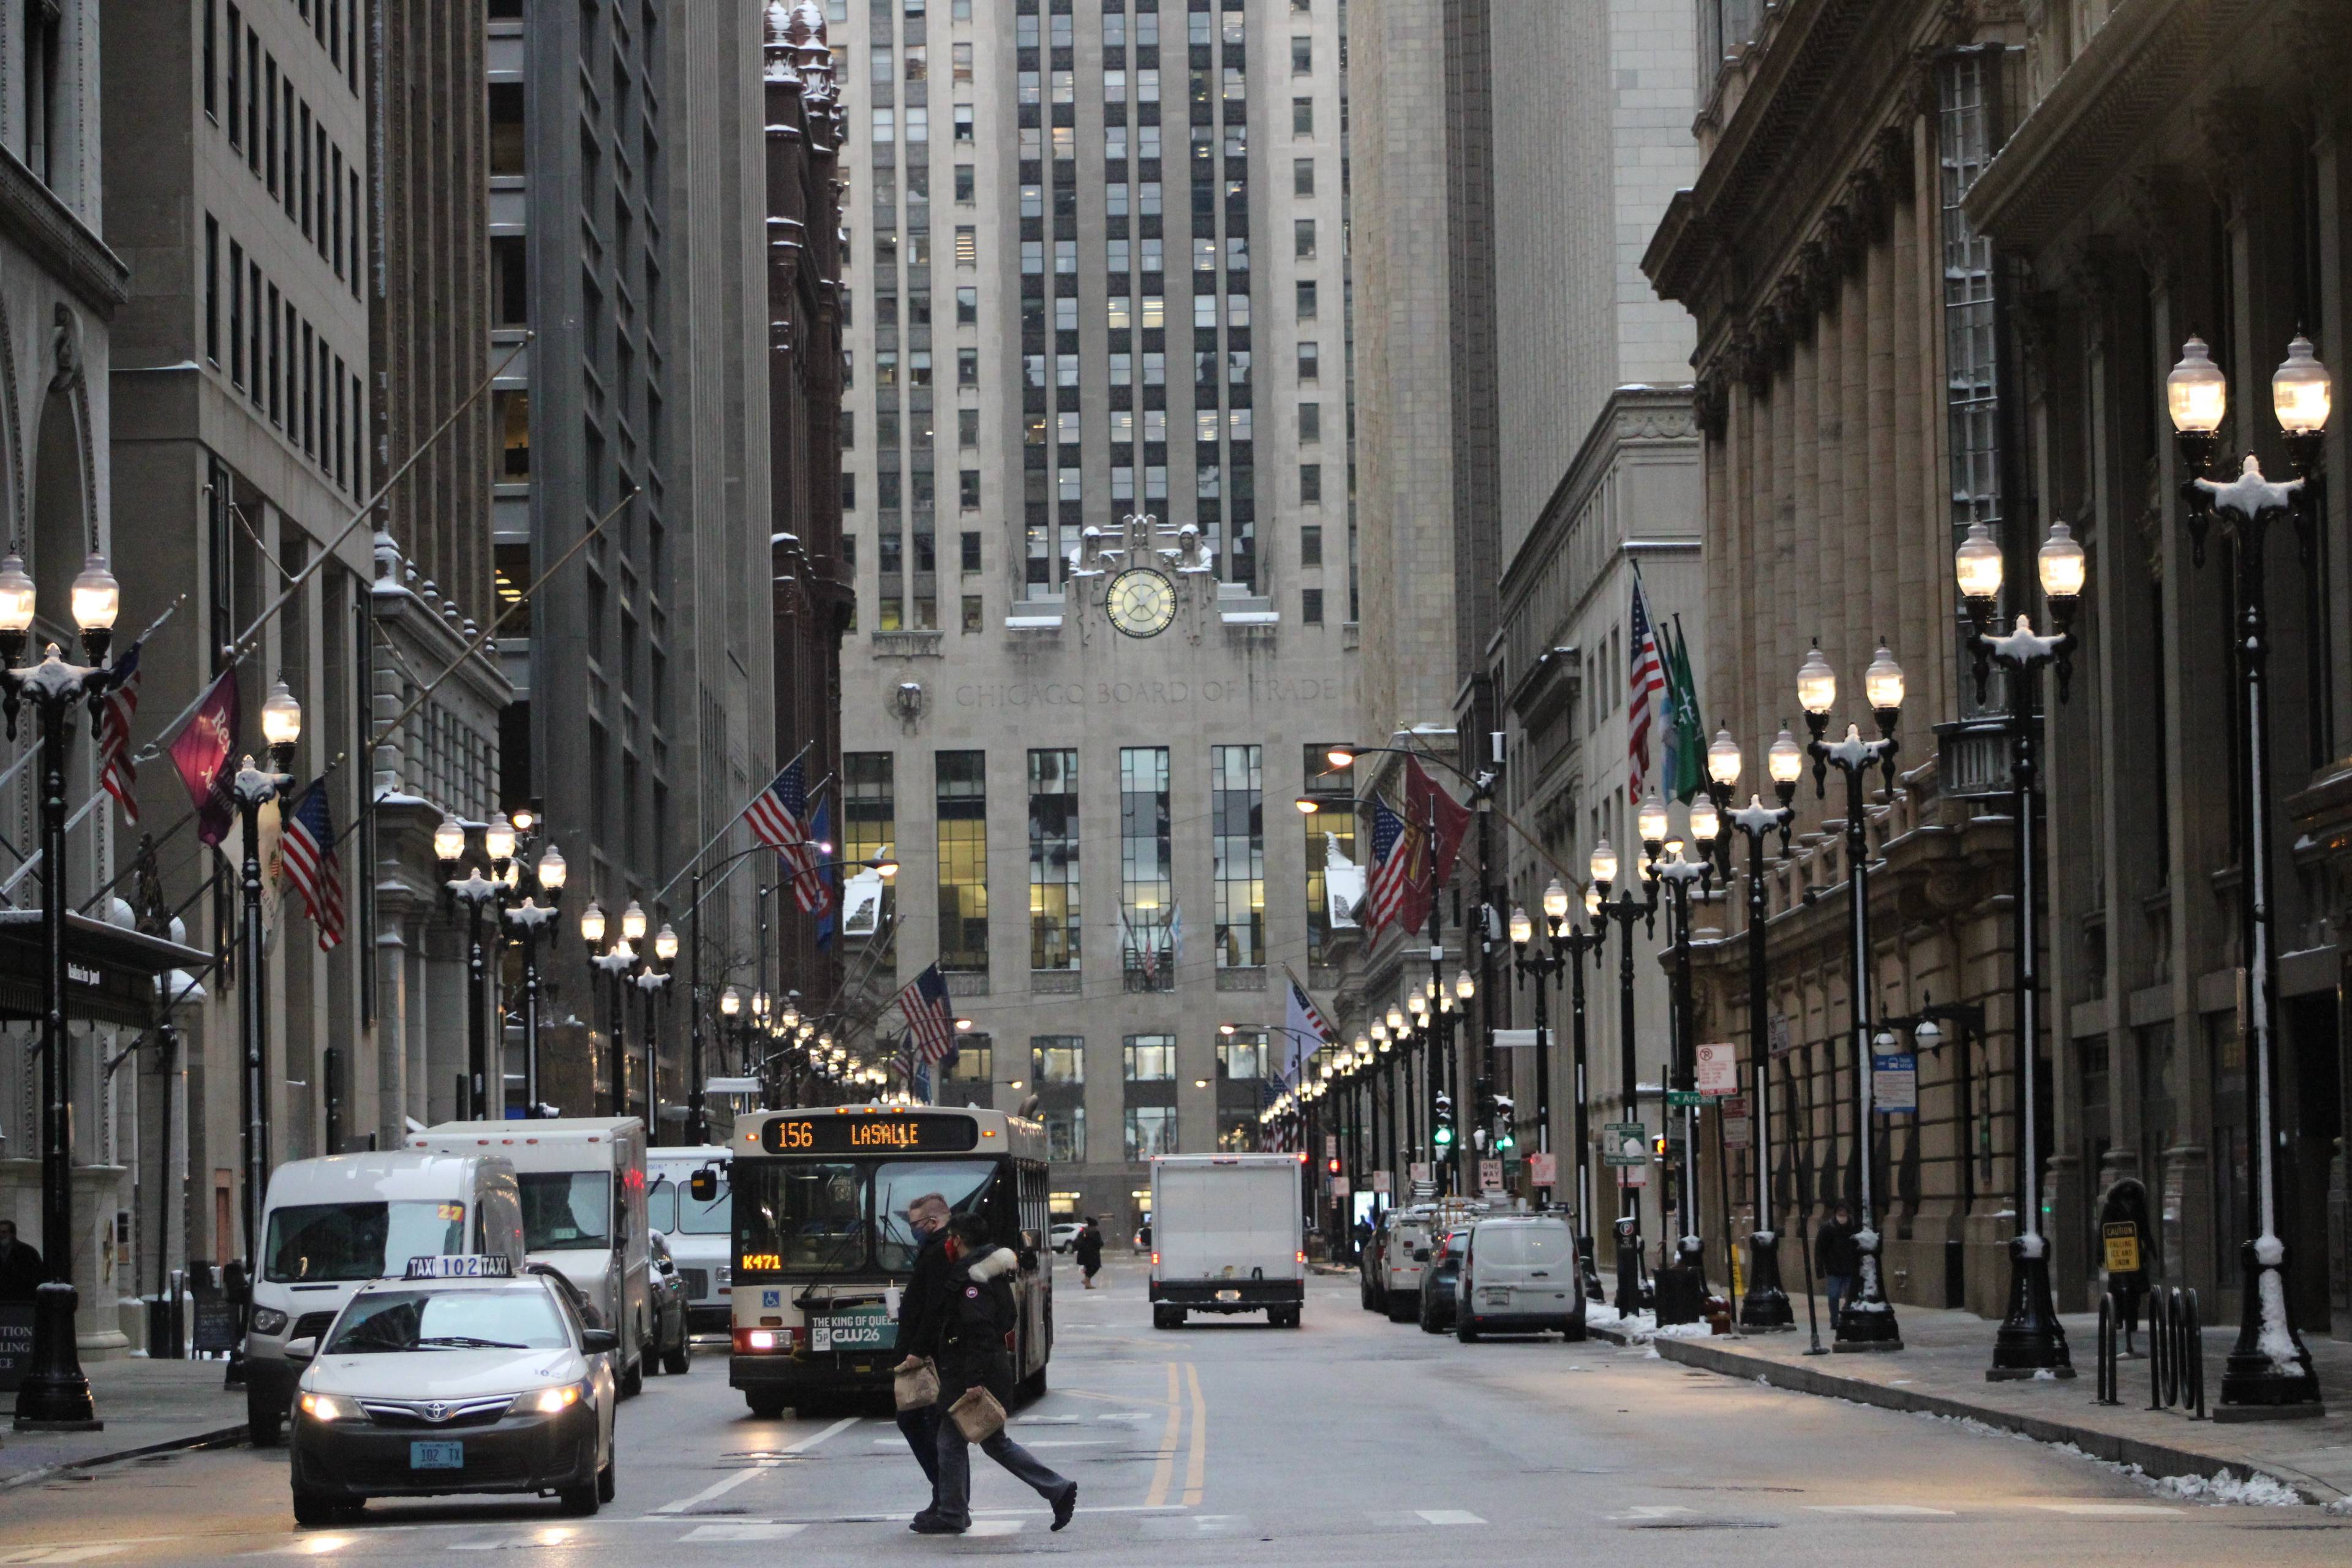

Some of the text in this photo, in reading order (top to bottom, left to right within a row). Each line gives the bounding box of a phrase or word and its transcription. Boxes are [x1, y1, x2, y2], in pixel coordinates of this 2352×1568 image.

[956, 678, 1337, 706] CHICAGO BOARD OF TRADE
[779, 1122, 918, 1147] 156 LASALLE
[438, 1204, 463, 1221] 27
[410, 1257, 507, 1276] TAXI 102 TAXI
[742, 1254, 781, 1270] K471
[812, 1315, 899, 1327] THE KING OF QUEE
[421, 1448, 461, 1462] 102 TX
